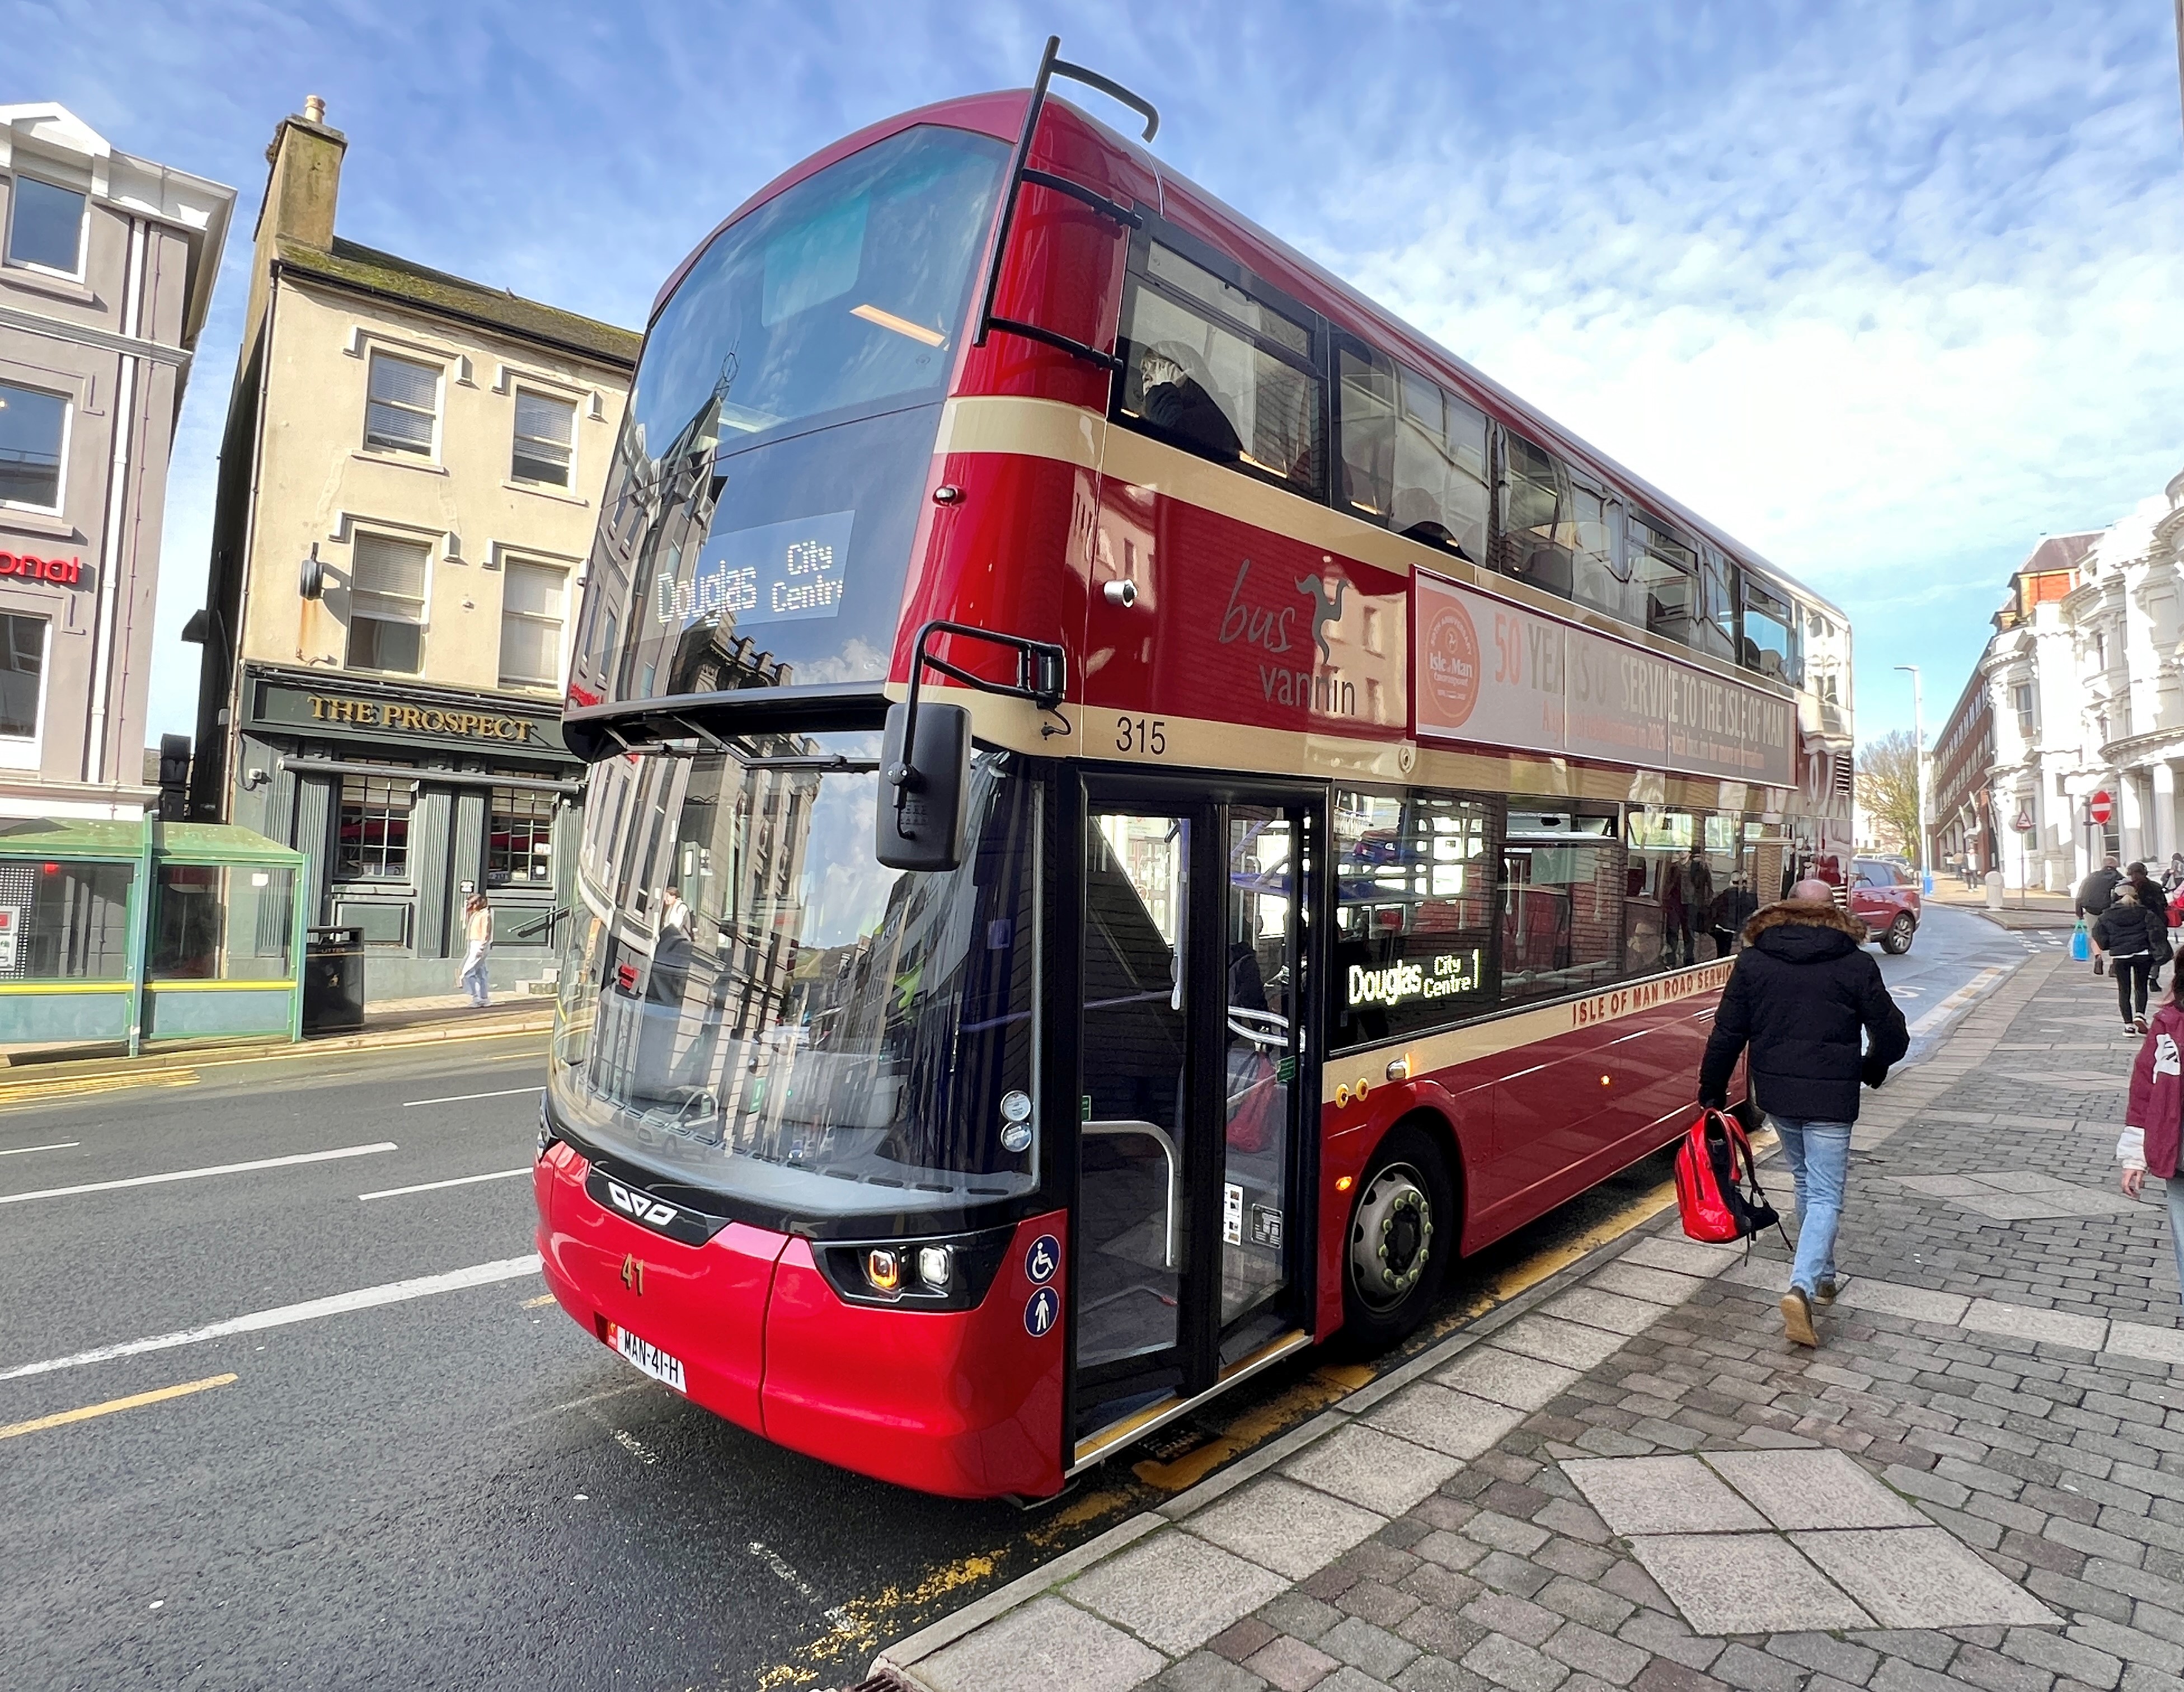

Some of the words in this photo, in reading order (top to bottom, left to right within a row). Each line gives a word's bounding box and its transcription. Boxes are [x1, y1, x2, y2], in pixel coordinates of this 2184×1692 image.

[788, 540, 832, 575] City
[657, 560, 756, 627] Douglas
[1219, 559, 1296, 653] bus
[1430, 650, 1447, 672] Isle
[1452, 657, 1473, 678] Man
[1495, 611, 1521, 686] 50
[1682, 674, 1697, 727] TO
[1701, 679, 1722, 734] THE
[1725, 688, 1746, 740] ISLE
[1748, 696, 1762, 742] OF
[1763, 701, 1784, 748] MAN
[1260, 664, 1355, 716] vannin
[307, 696, 374, 723] THE
[381, 704, 533, 740] PROSPECT
[1116, 716, 1165, 755] 315
[1349, 959, 1422, 1005] Douglas
[1424, 974, 1471, 998] Centre
[1434, 955, 1461, 976] City
[1574, 997, 1604, 1025] ISLE
[1611, 991, 1627, 1016] OF
[1633, 983, 1659, 1009] MAN
[1664, 975, 1693, 1000] ROAD
[622, 1253, 644, 1296] 41
[624, 1330, 679, 1384] MAN-41-H
